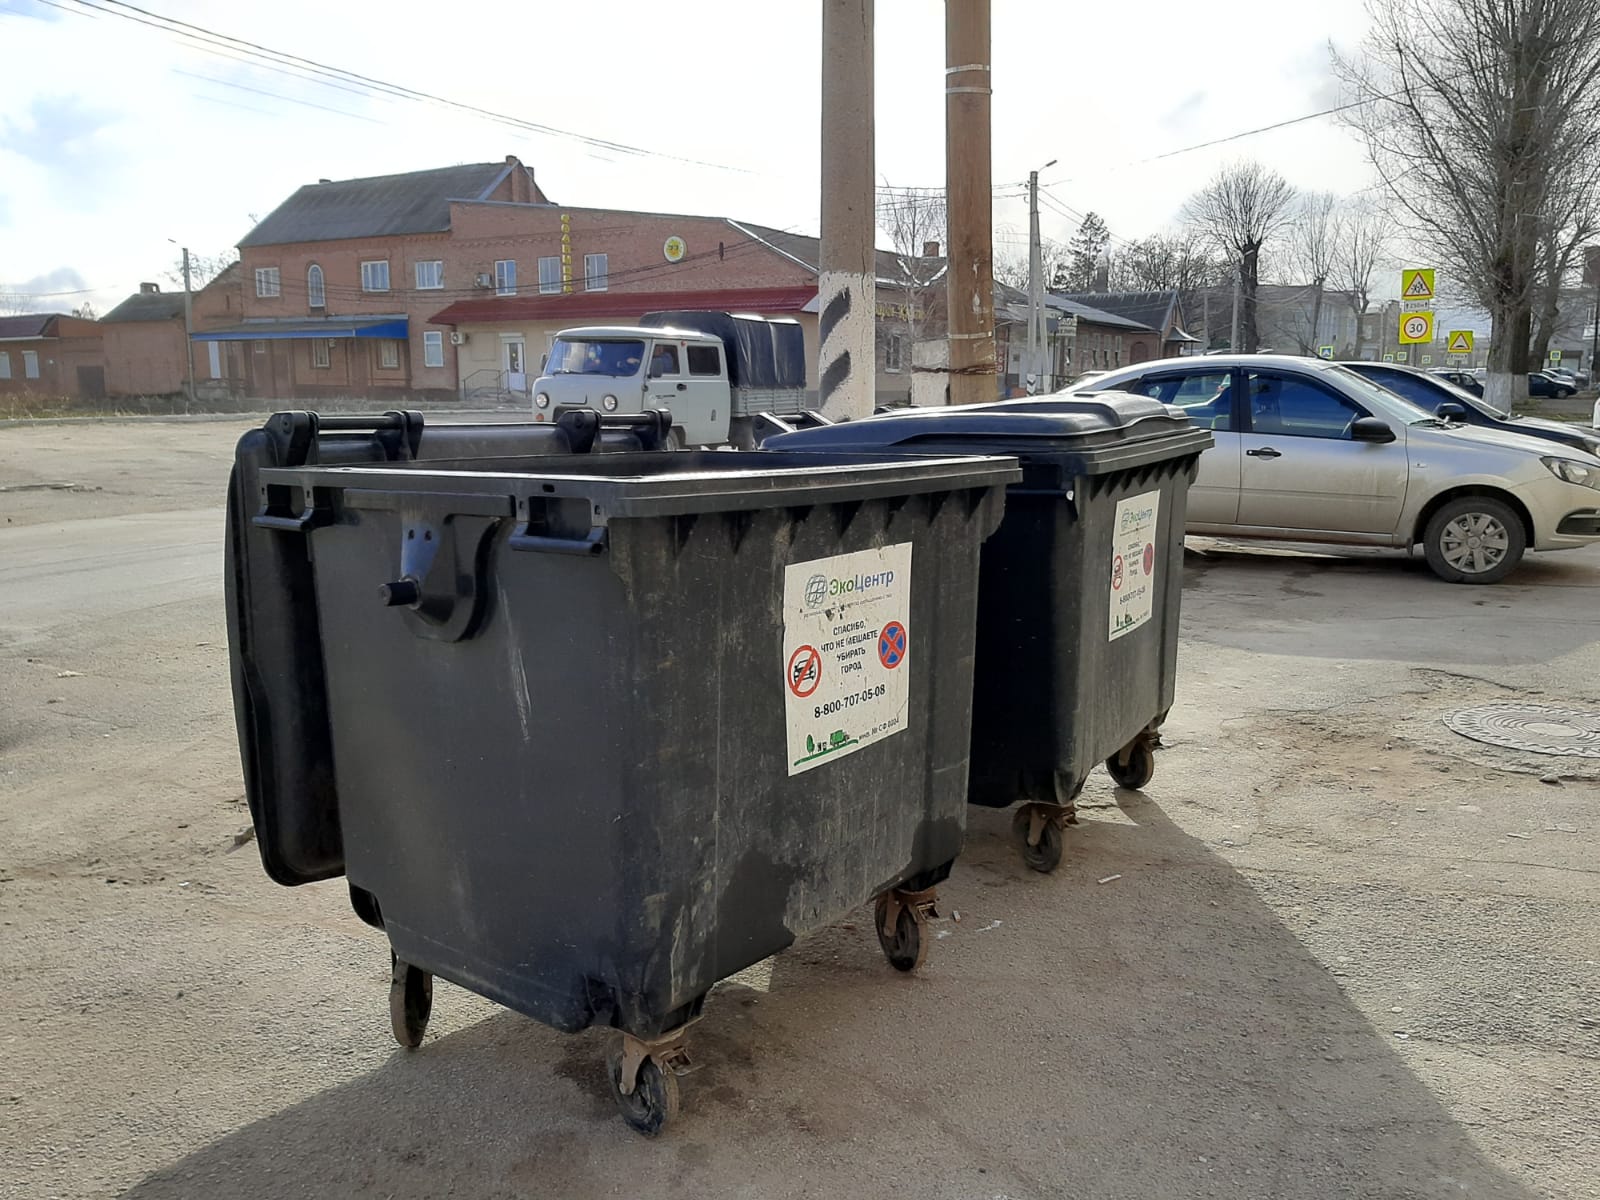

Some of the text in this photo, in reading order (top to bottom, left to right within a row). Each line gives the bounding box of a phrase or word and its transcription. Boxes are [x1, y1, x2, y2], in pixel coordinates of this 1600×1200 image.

[1409, 323, 1423, 333] 30
[829, 570, 894, 596] ЭкоЦентр
[821, 641, 834, 653] ЧТО
[836, 638, 845, 649] НЕ
[836, 647, 866, 662] УБИРАТЬ
[841, 661, 862, 675] ГОРОД
[814, 684, 886, 718] 8-800-707-05-08
